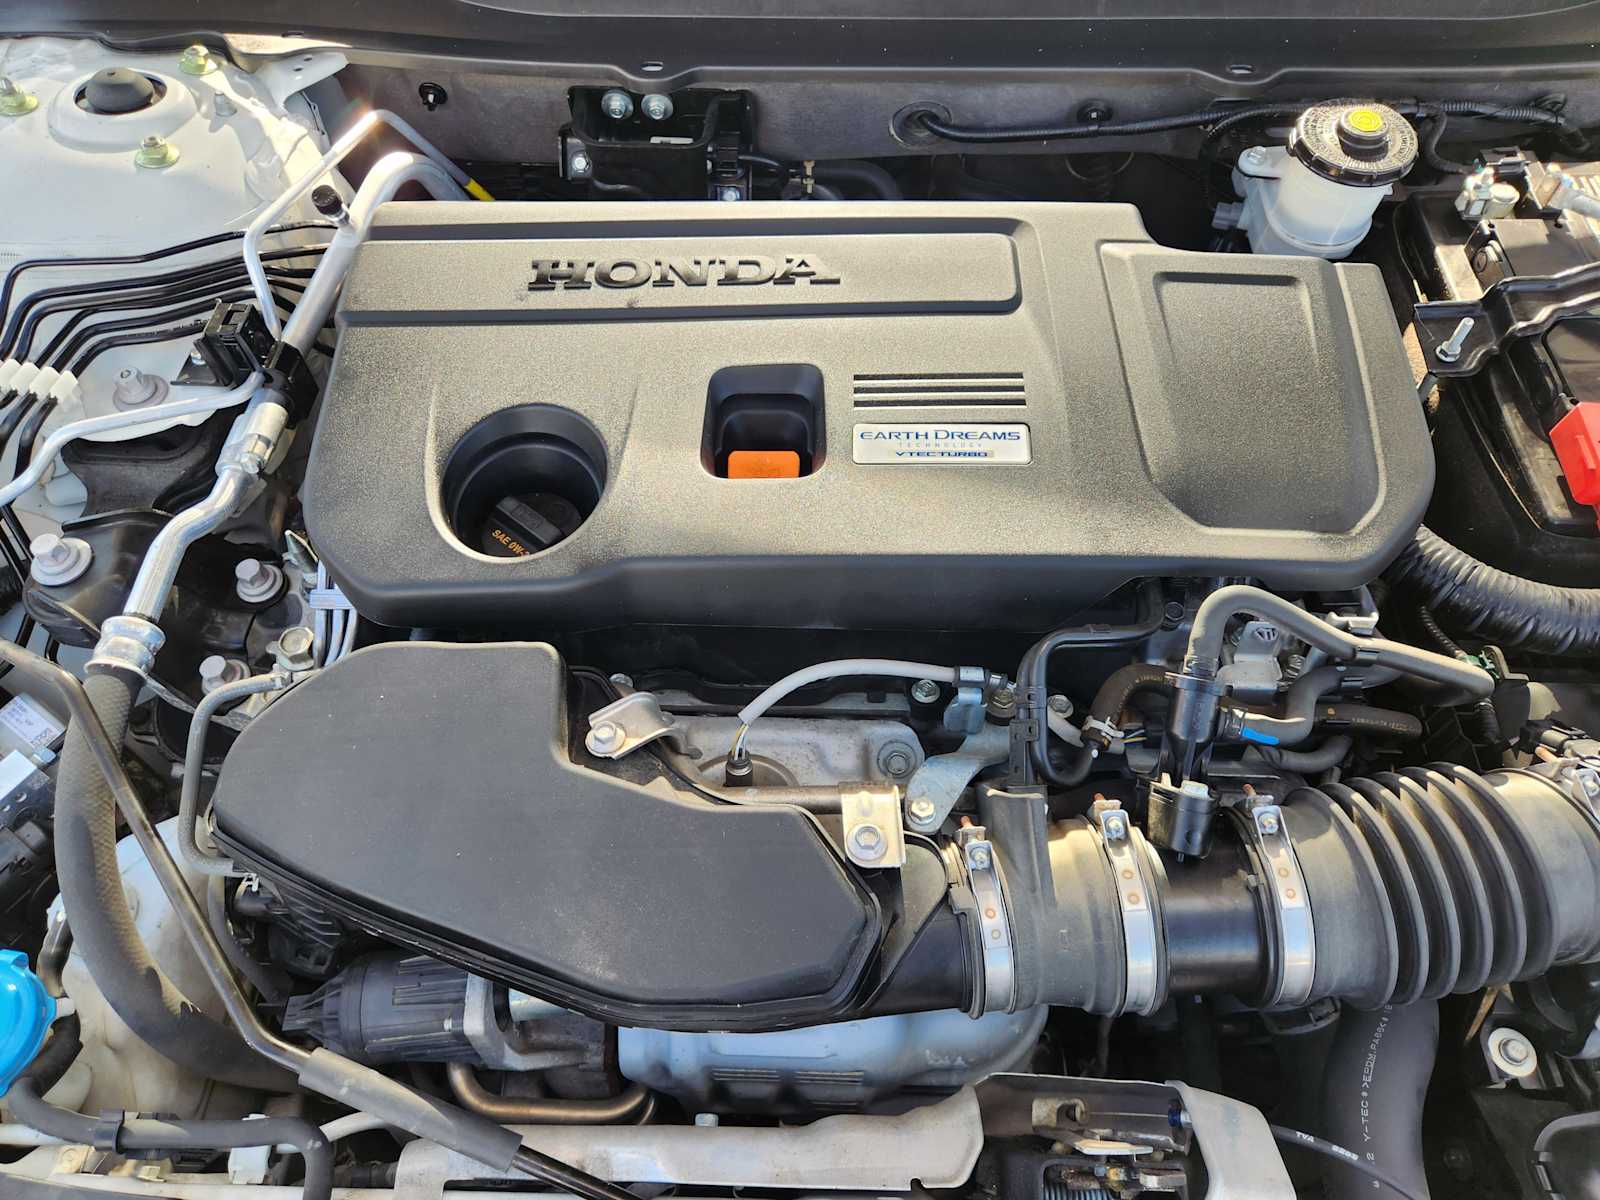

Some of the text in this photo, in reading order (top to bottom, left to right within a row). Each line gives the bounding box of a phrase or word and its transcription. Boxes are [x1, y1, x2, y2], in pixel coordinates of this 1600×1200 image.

[528, 256, 840, 291] HONDA
[860, 430, 1021, 441] EARTH DREAMS
[492, 529, 512, 545] SAE
